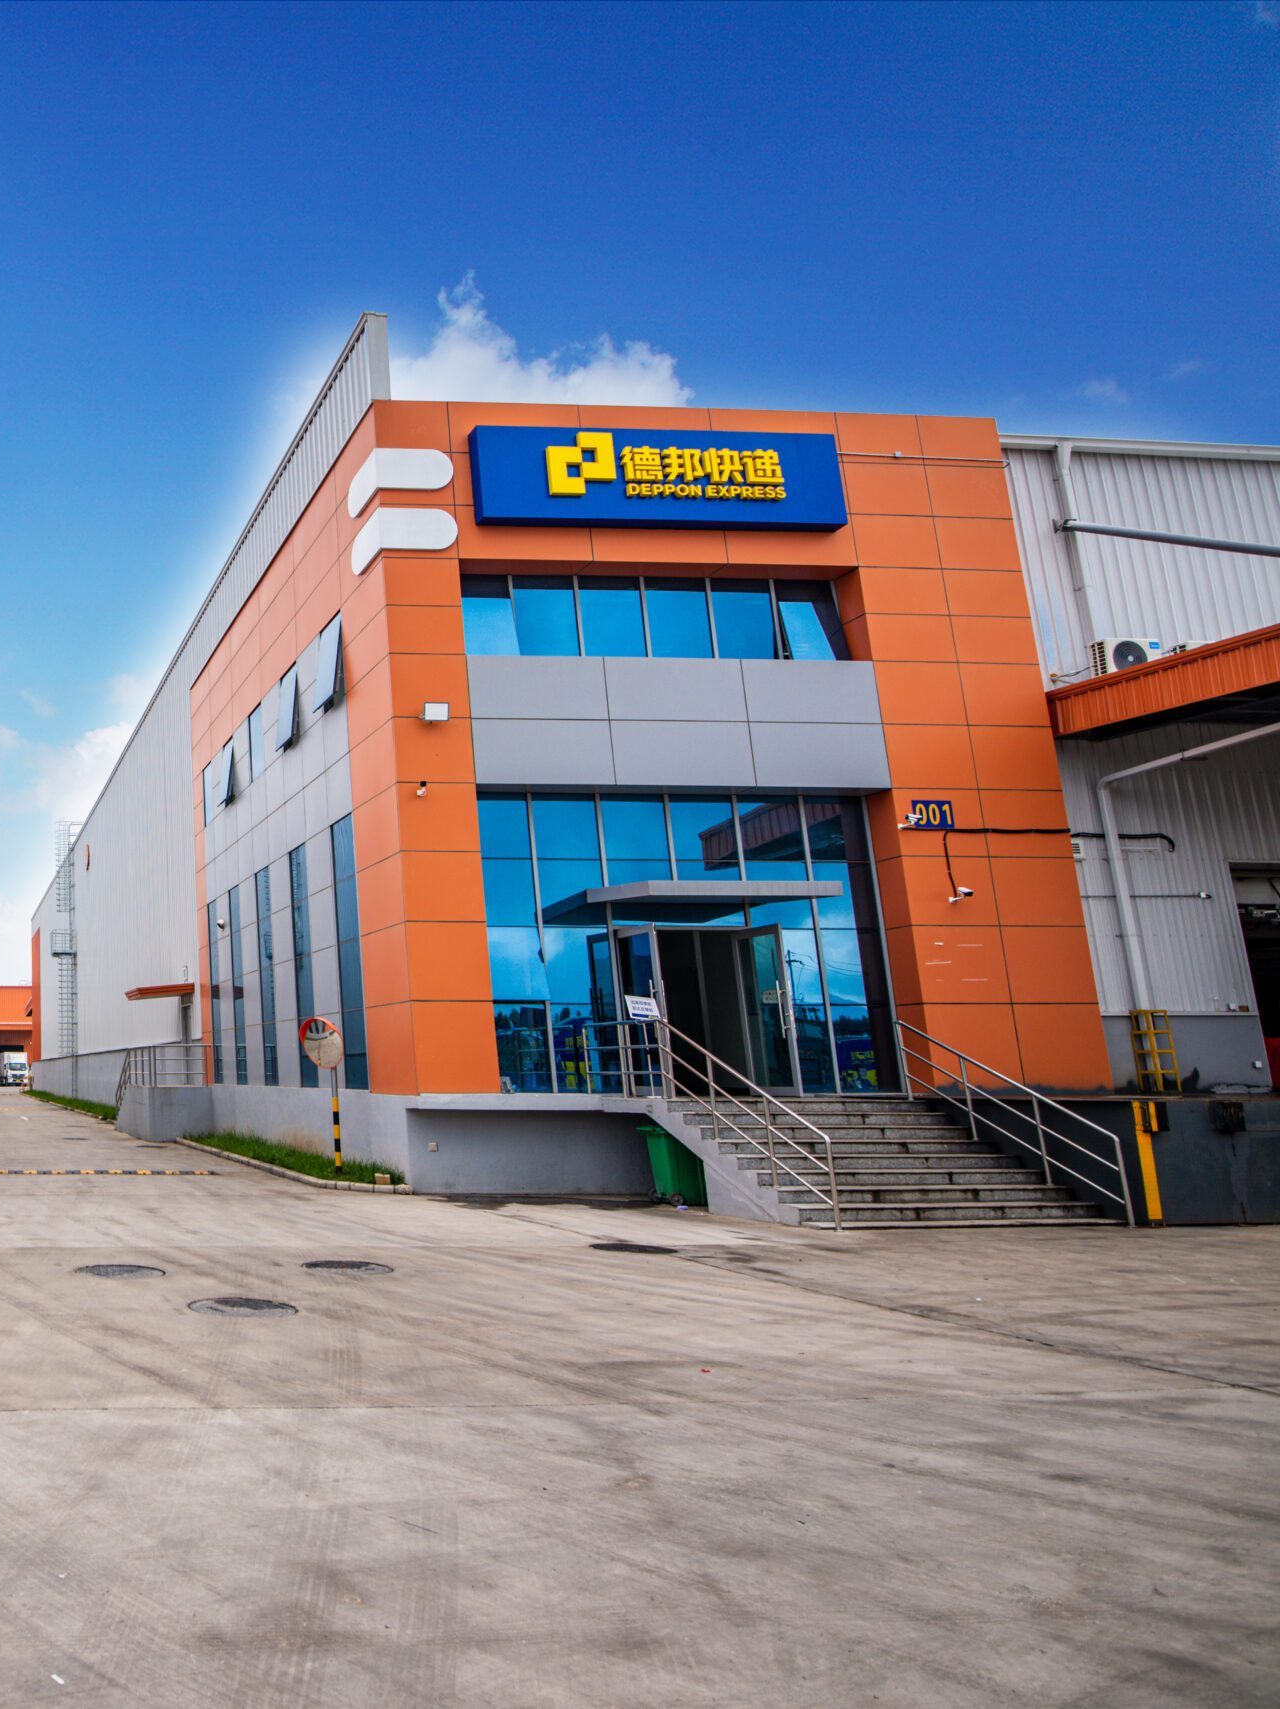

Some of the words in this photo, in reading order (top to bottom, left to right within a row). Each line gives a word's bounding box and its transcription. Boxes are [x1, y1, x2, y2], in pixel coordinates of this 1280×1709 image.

[620, 446, 785, 484] 德邦快递
[626, 483, 702, 497] DEPPON
[705, 485, 787, 500] EXPRESS
[915, 803, 952, 825] 001
